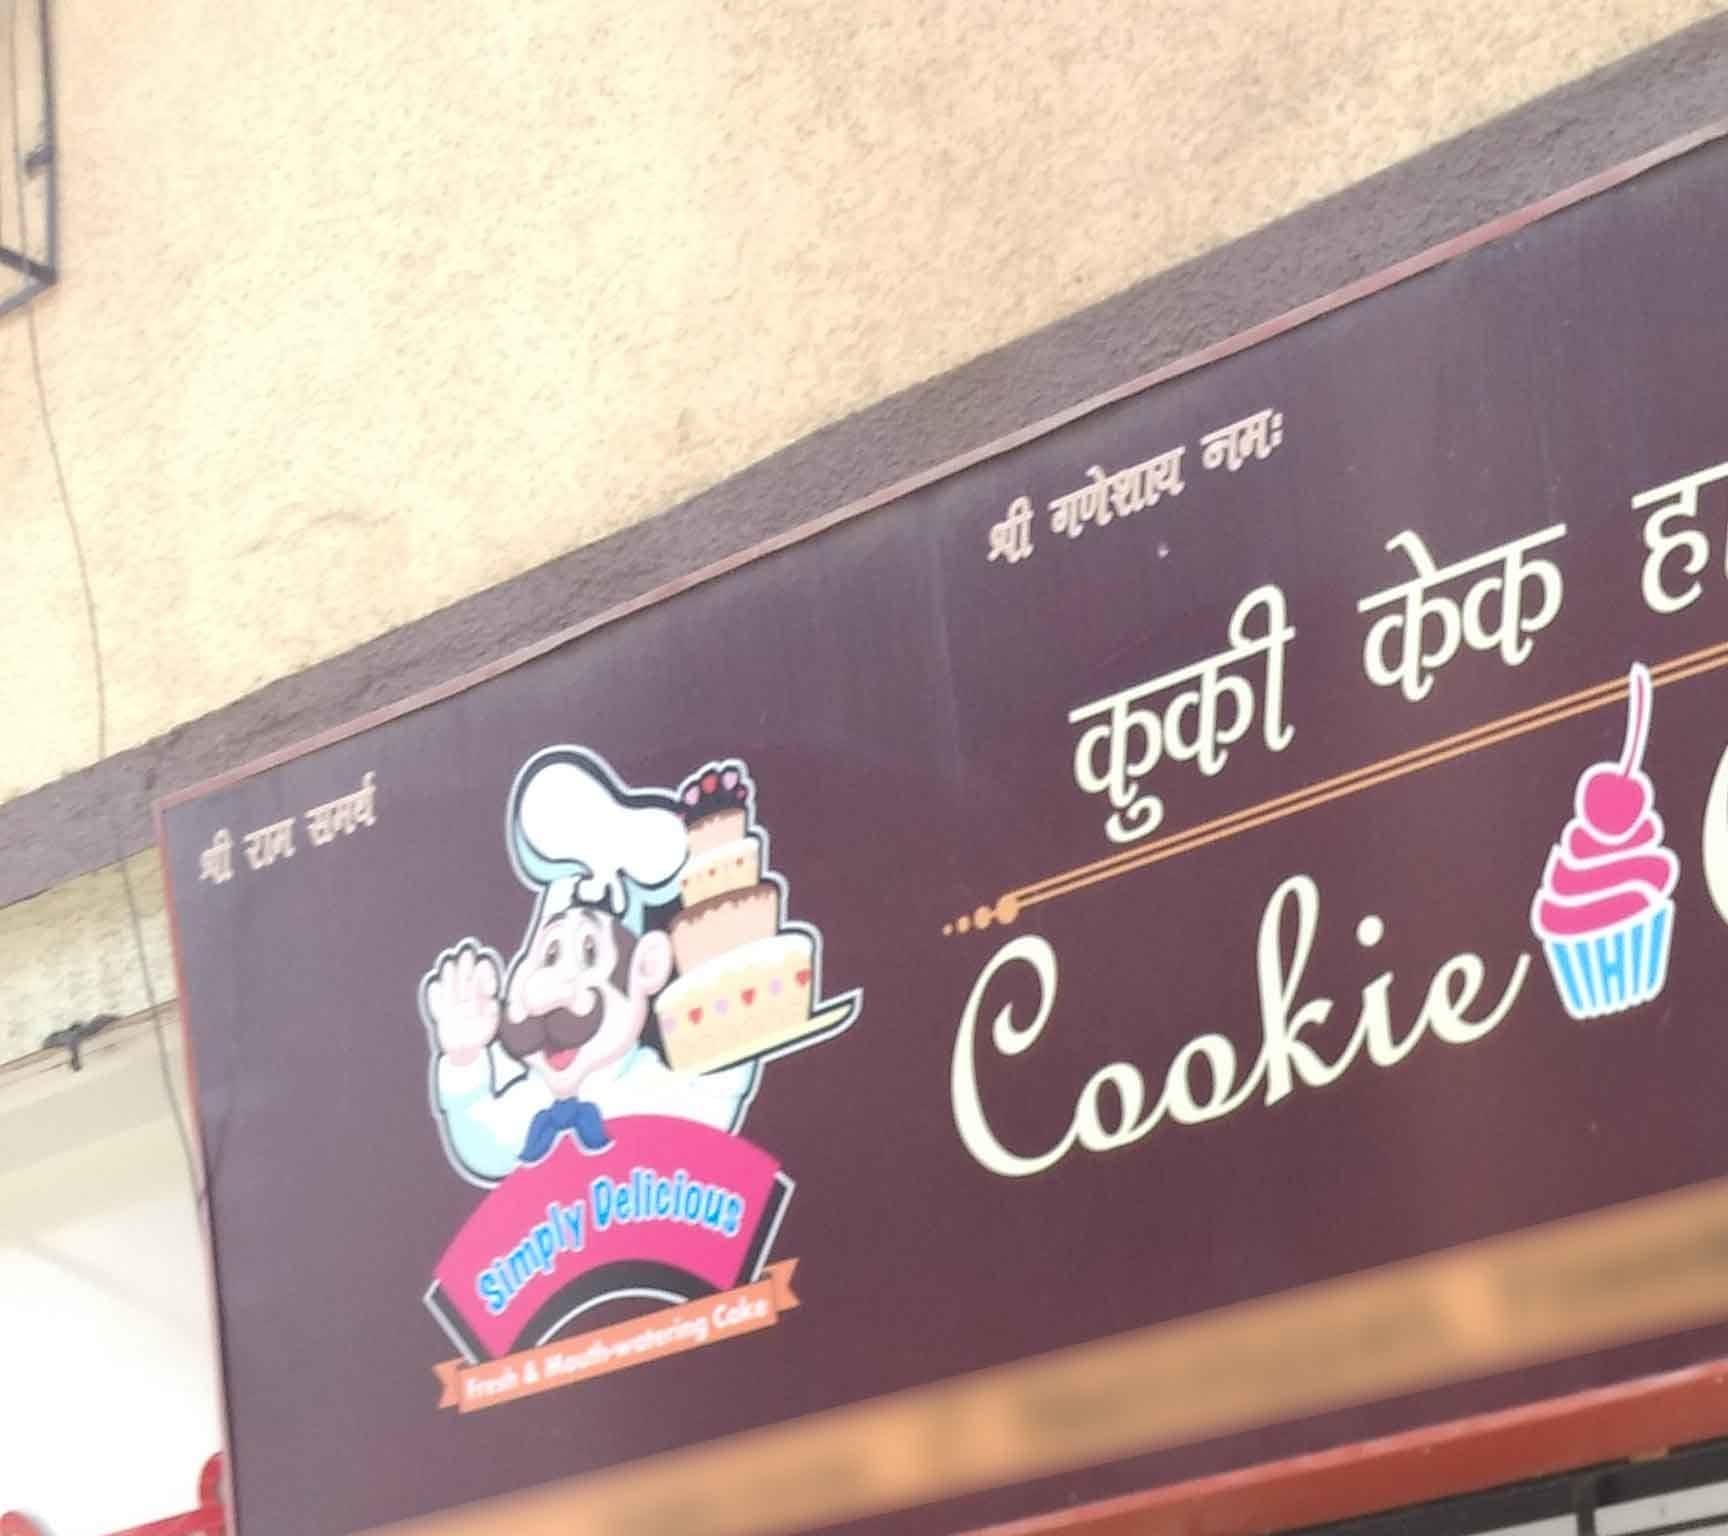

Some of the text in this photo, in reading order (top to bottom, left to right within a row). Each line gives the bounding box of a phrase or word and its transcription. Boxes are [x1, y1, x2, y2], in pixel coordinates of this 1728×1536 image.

[986, 495, 1034, 563] श्री
[1048, 446, 1186, 538] गणेशाय
[1069, 583, 1295, 842] कुकी
[1358, 529, 1567, 700] केक
[199, 770, 377, 884] श्री राम समर्थ
[951, 874, 1531, 1176] Cookie
[476, 1165, 743, 1314] Simply Delicious
